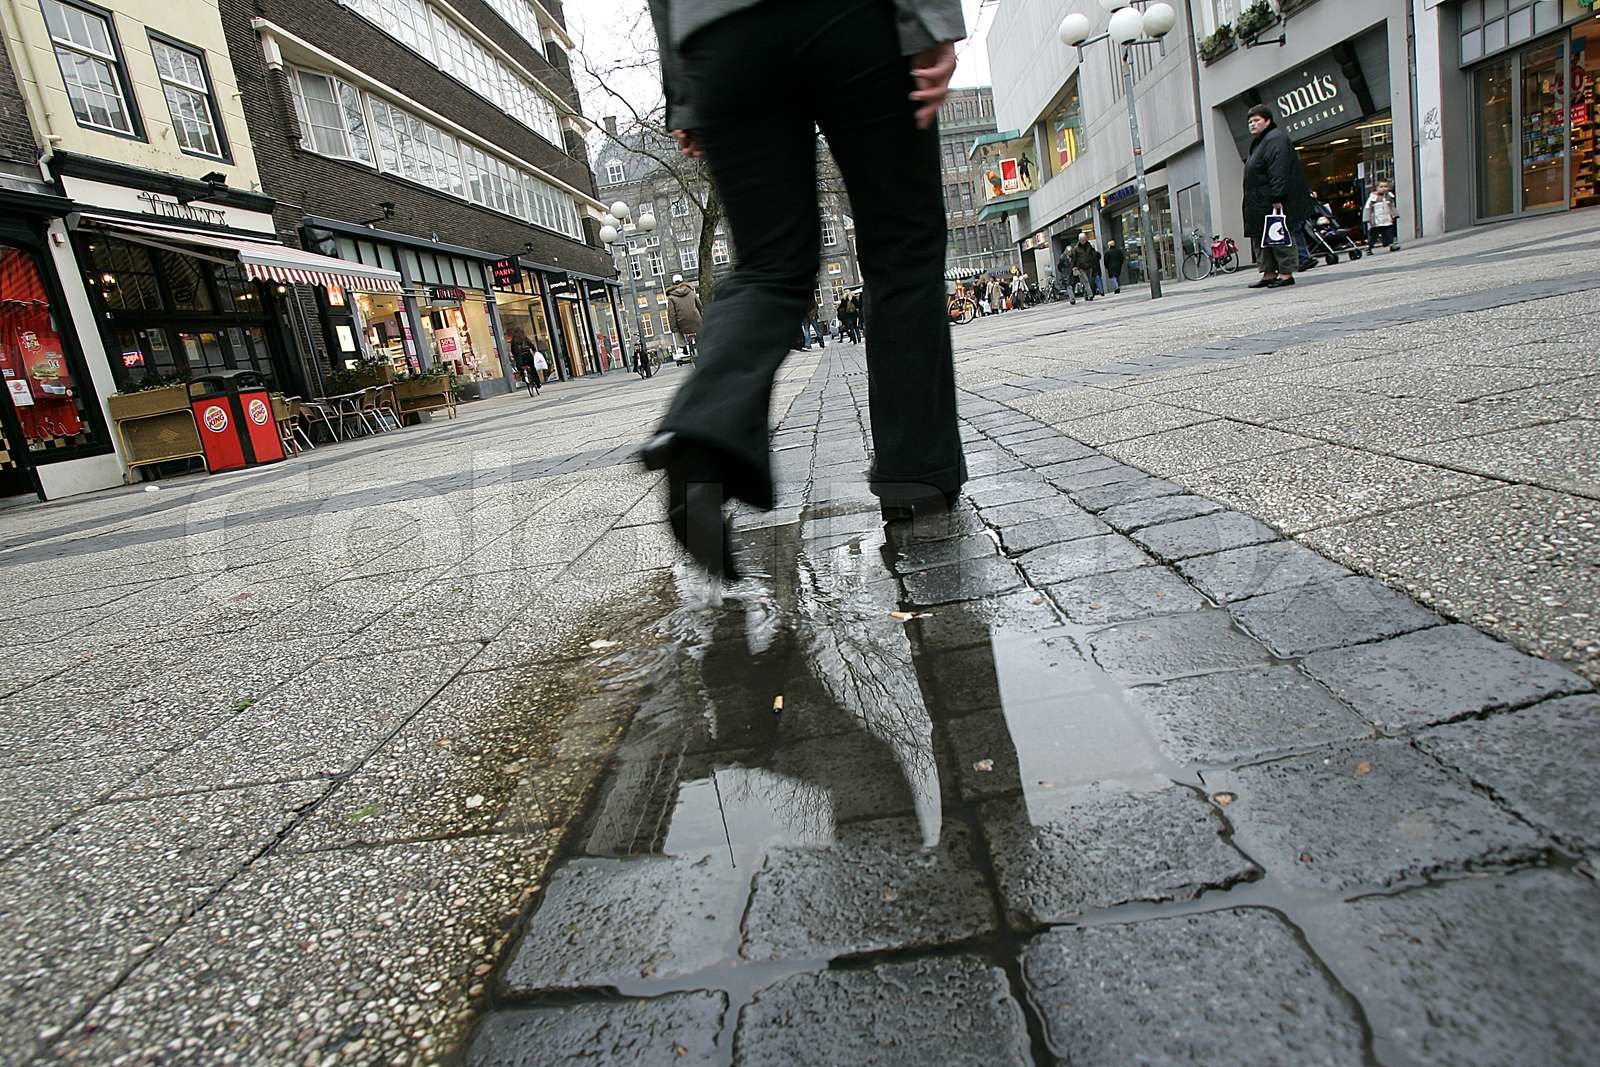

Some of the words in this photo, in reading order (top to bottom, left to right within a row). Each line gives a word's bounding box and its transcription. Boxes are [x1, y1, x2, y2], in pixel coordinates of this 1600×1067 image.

[1277, 71, 1337, 118] smits
[1286, 104, 1345, 133] SCHOENEN
[497, 260, 509, 269] ICI
[495, 267, 515, 276] PARIS
[207, 410, 222, 421] BURGER
[253, 408, 266, 419] KING
[209, 414, 225, 427] KING
